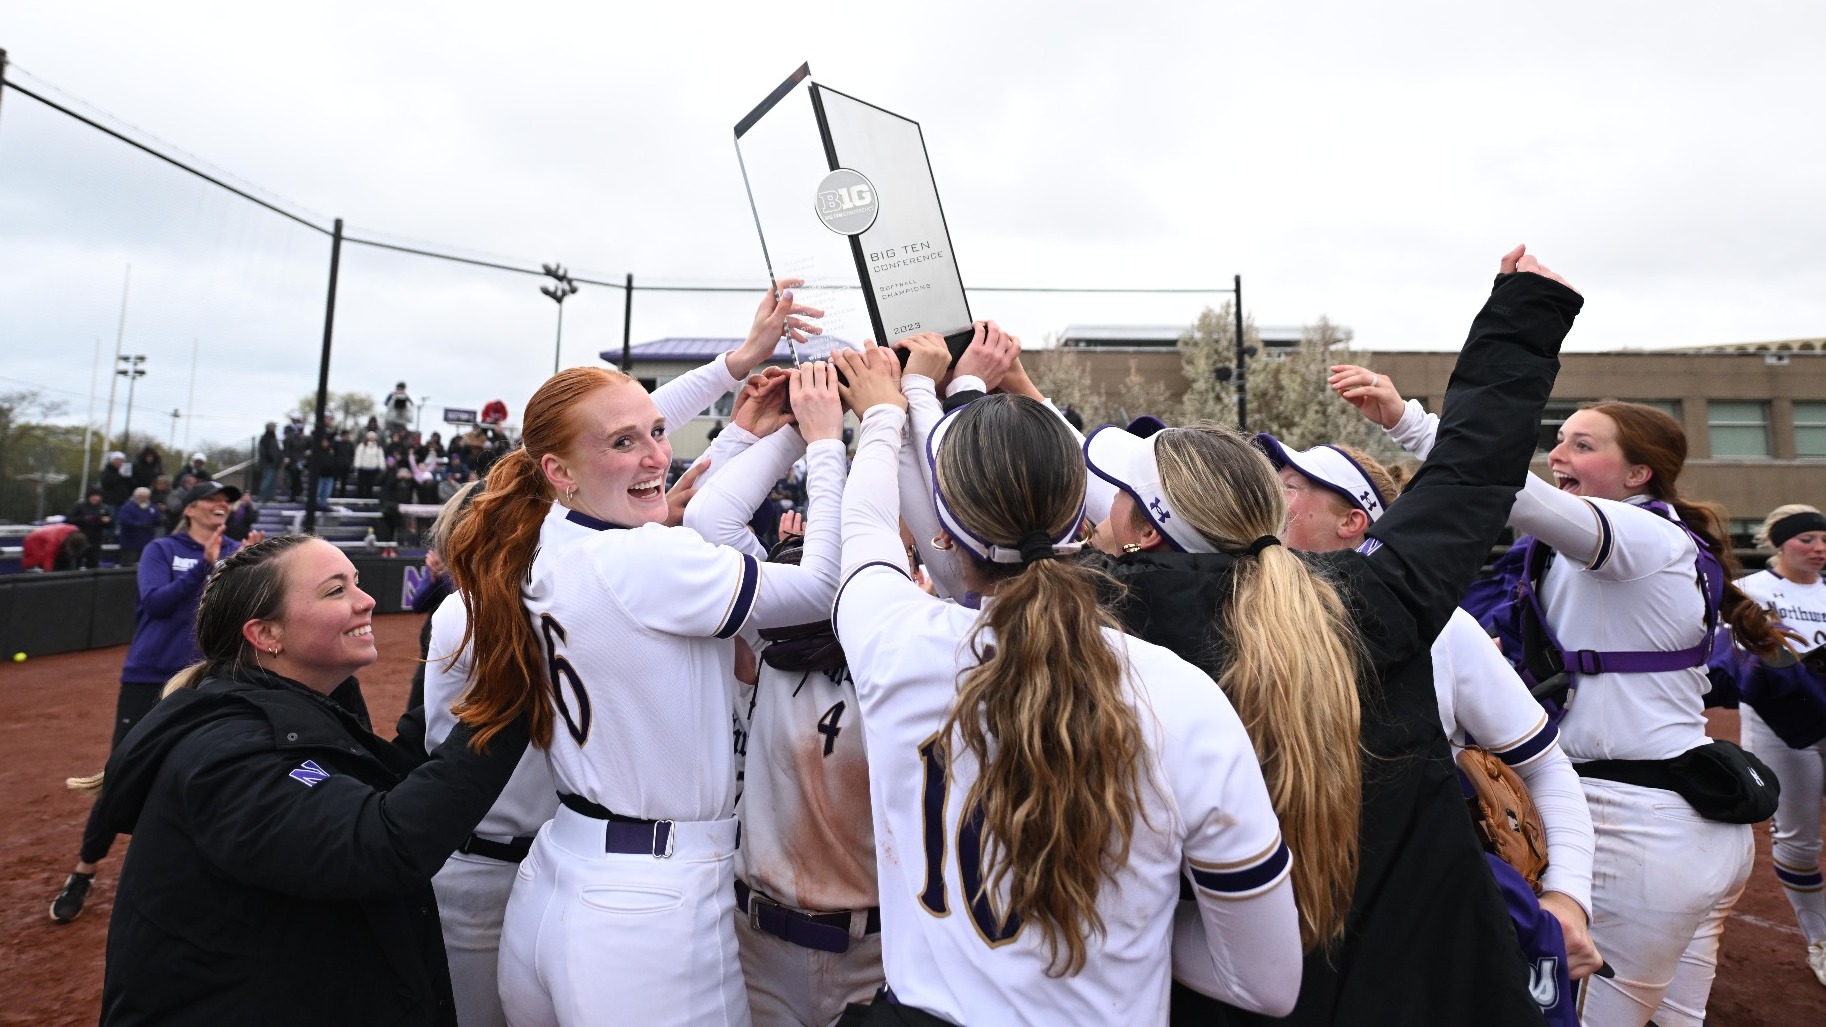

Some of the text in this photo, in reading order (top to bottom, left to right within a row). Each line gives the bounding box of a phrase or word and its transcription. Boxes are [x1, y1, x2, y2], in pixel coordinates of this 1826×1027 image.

[870, 241, 930, 262] BIG TEN
[873, 251, 943, 273] CONFERENCE
[882, 283, 931, 300] CHAMPIONS
[893, 322, 921, 335] 2023
[540, 612, 593, 749] 6
[817, 700, 846, 758] 4
